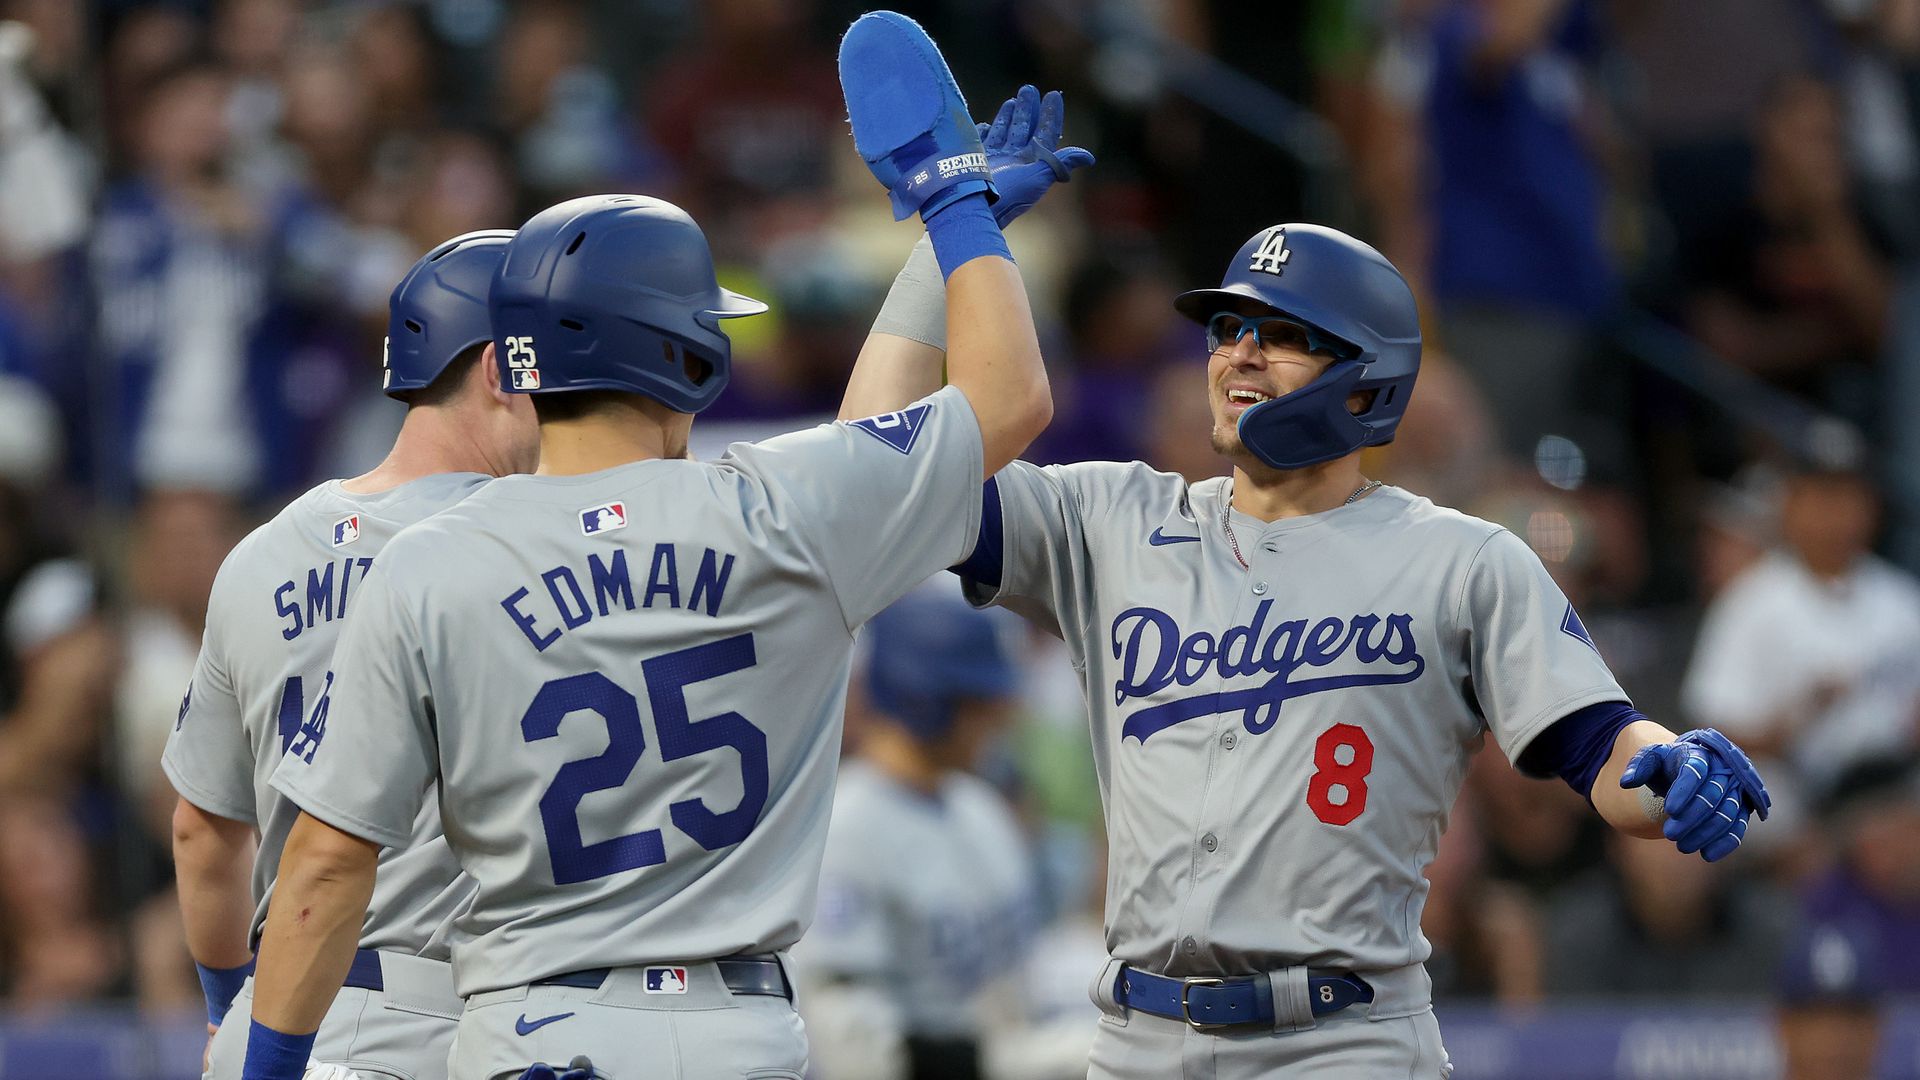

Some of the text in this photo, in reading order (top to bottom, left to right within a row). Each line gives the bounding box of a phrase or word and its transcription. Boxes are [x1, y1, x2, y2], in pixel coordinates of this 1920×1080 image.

[914, 170, 928, 185] 25
[1250, 227, 1290, 274] LA
[505, 336, 536, 368] 25
[500, 543, 735, 653] EDMAN
[1112, 598, 1425, 746] Dodgers
[520, 632, 769, 885] 25
[1306, 722, 1374, 827] 8
[1320, 985, 1334, 1003] 8
